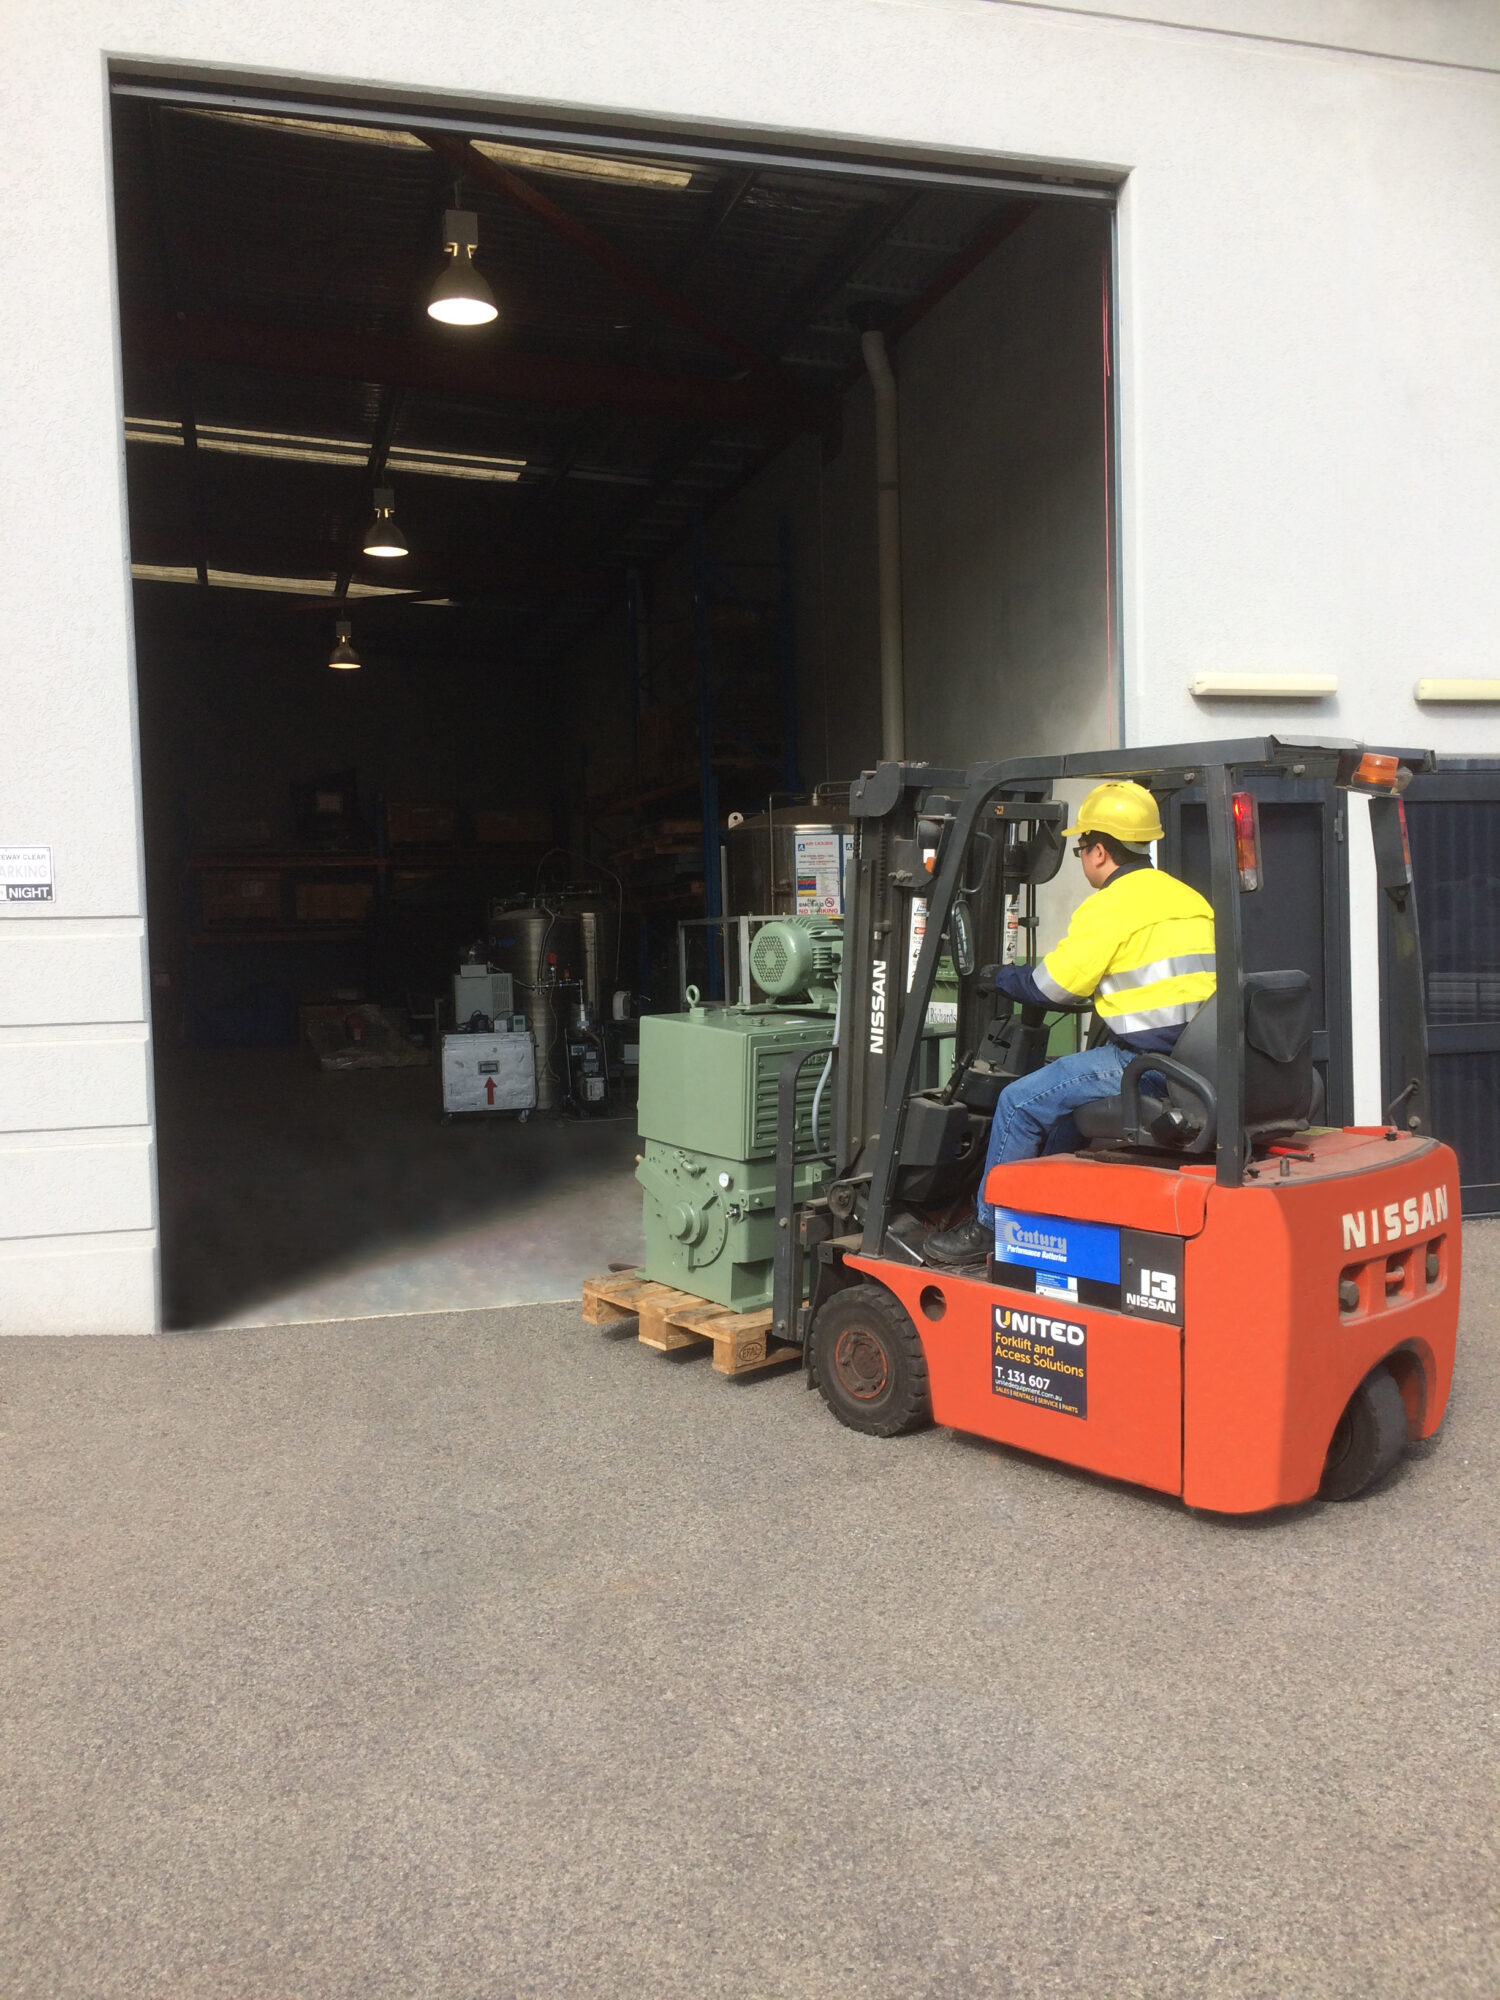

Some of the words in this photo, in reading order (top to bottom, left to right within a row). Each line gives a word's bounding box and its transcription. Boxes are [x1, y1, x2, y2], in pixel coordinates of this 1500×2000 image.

[870, 960, 887, 1054] NISSAN
[1342, 1184, 1448, 1251] NISSAN
[1004, 1221, 1067, 1254] Century
[1006, 1244, 1041, 1257] Performance
[1041, 1251, 1067, 1262] Batteries
[1126, 1292, 1176, 1314] NISSAN
[995, 1308, 1085, 1346] UNITED
[995, 1332, 1032, 1351] Forklift
[1034, 1343, 1055, 1357] and
[995, 1345, 1031, 1364] Access
[1033, 1354, 1084, 1377] Solutions
[995, 1365, 1005, 1379] T.
[1007, 1369, 1026, 1385] 131
[1028, 1375, 1050, 1390] 607
[996, 1386, 1010, 1394] SALES
[1013, 1390, 1034, 1402] RENTALS
[1062, 1404, 1079, 1413] PARTS
